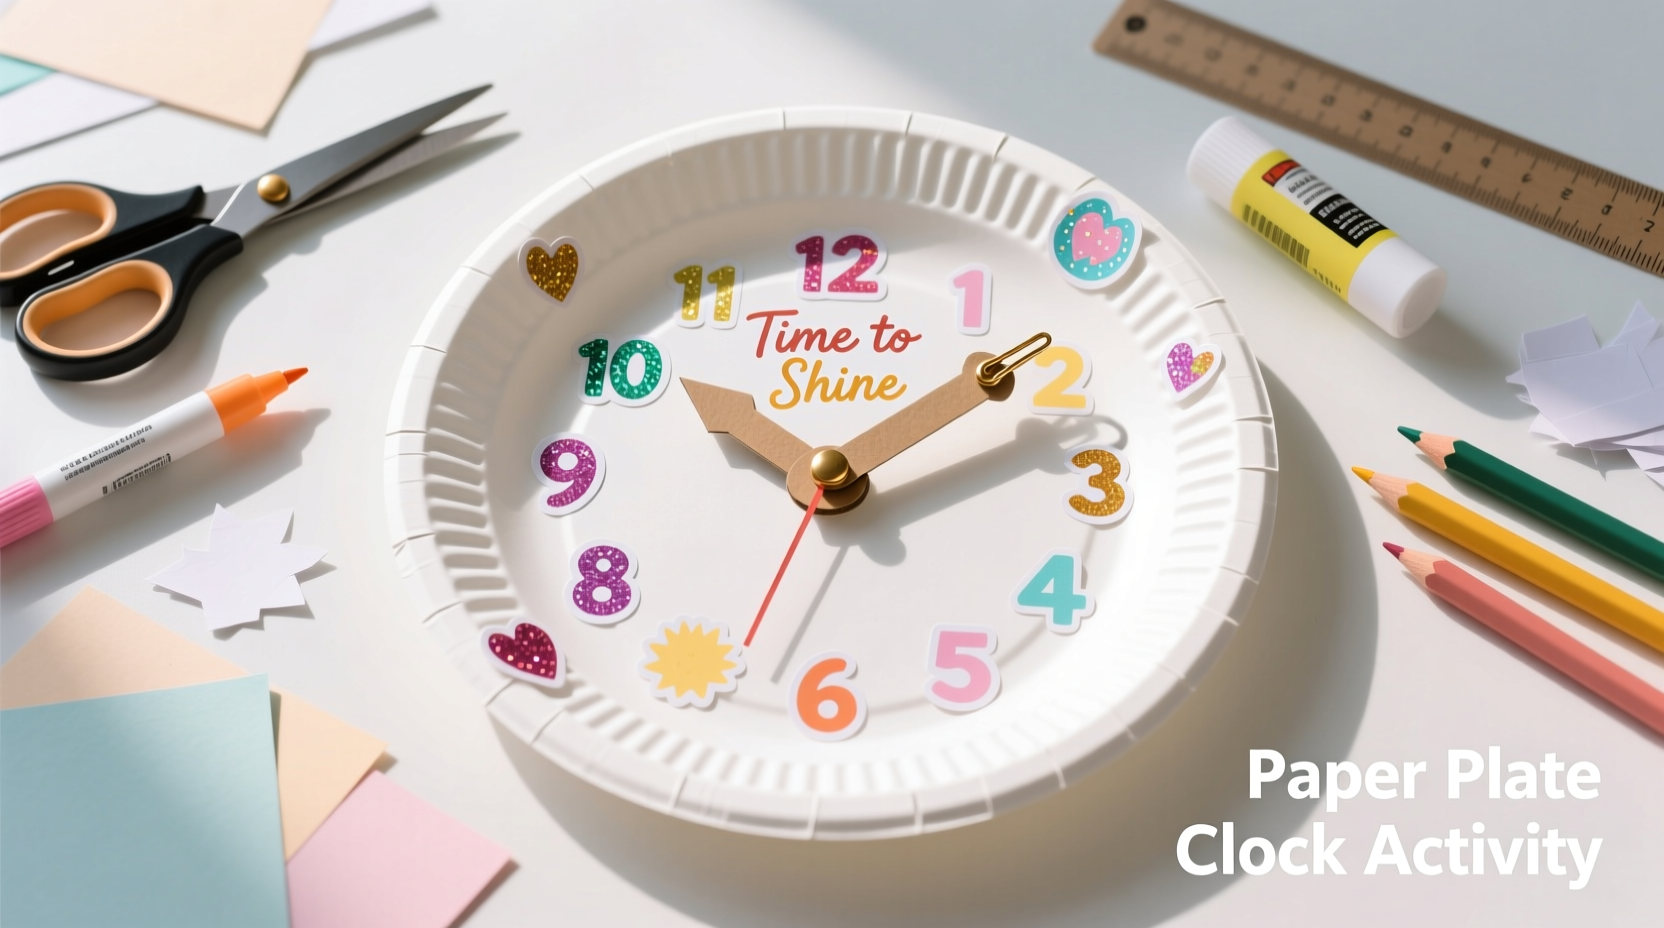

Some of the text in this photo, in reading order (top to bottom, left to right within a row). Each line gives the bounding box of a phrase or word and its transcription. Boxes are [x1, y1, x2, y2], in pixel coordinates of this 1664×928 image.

[673, 264, 736, 323] 11
[795, 234, 880, 295] 12
[951, 270, 985, 328] 1
[746, 308, 923, 359] Time to
[578, 338, 663, 401] 10
[769, 357, 908, 411] Shine
[1032, 345, 1087, 409] 2
[539, 438, 597, 508] 9
[1067, 448, 1126, 518] 3
[572, 545, 632, 617] 8
[1017, 554, 1087, 626] 4
[796, 657, 858, 734] 6
[932, 630, 991, 703] 5
